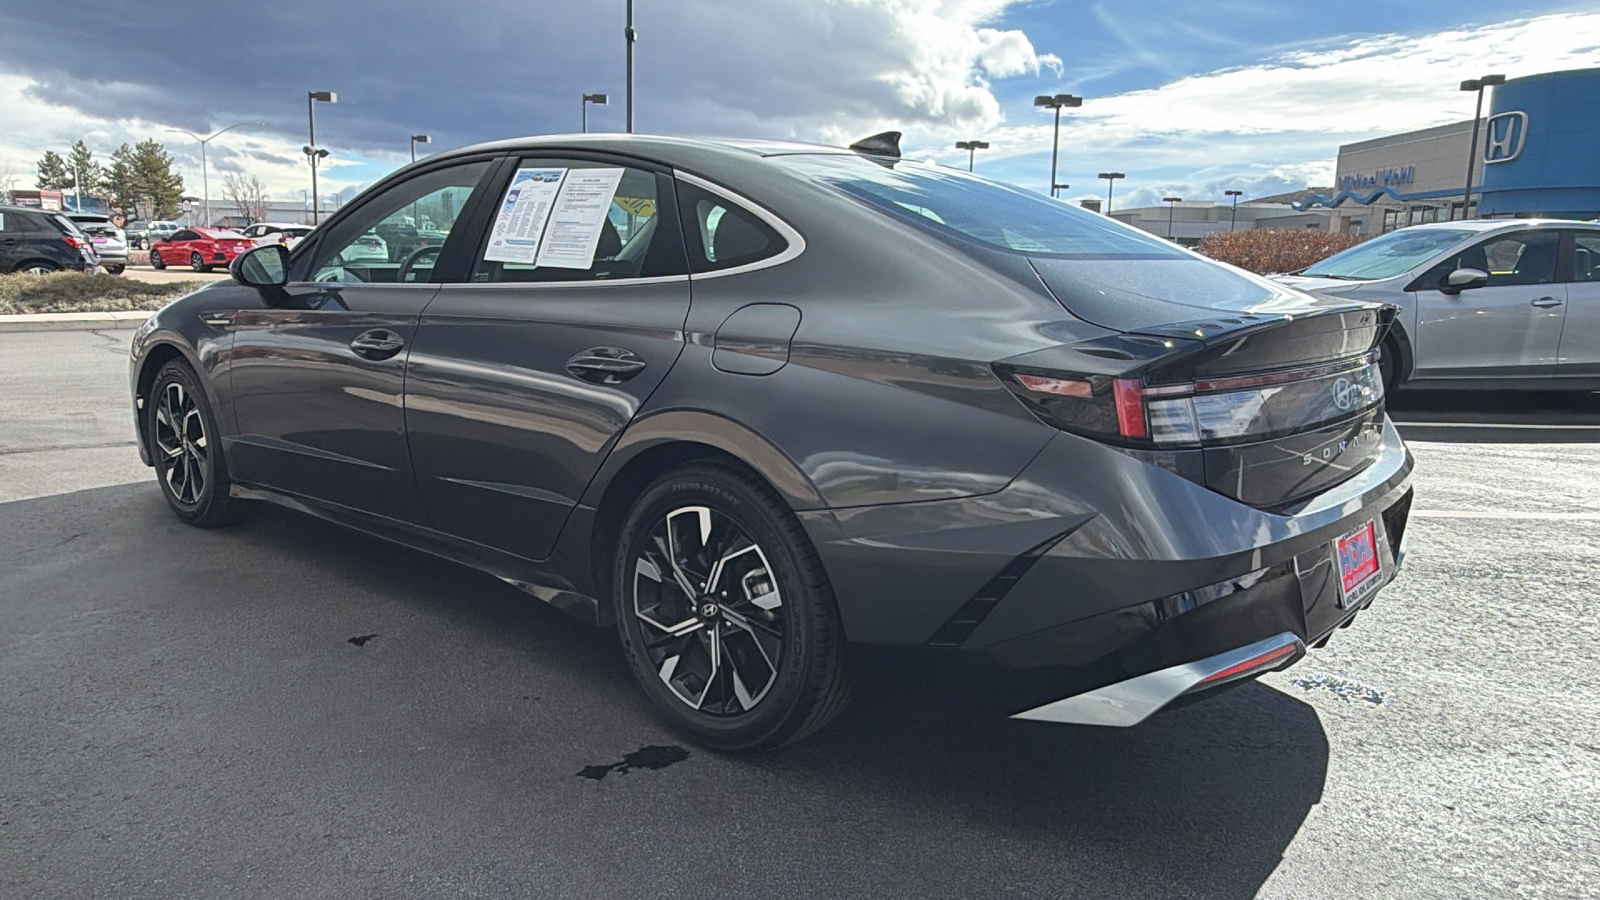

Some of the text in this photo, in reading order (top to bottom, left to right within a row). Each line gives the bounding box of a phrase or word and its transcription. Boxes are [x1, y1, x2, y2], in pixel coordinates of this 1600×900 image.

[1382, 166, 1415, 186] Hohl
[1302, 425, 1377, 465] SONATA
[1339, 531, 1373, 577] HOHL
